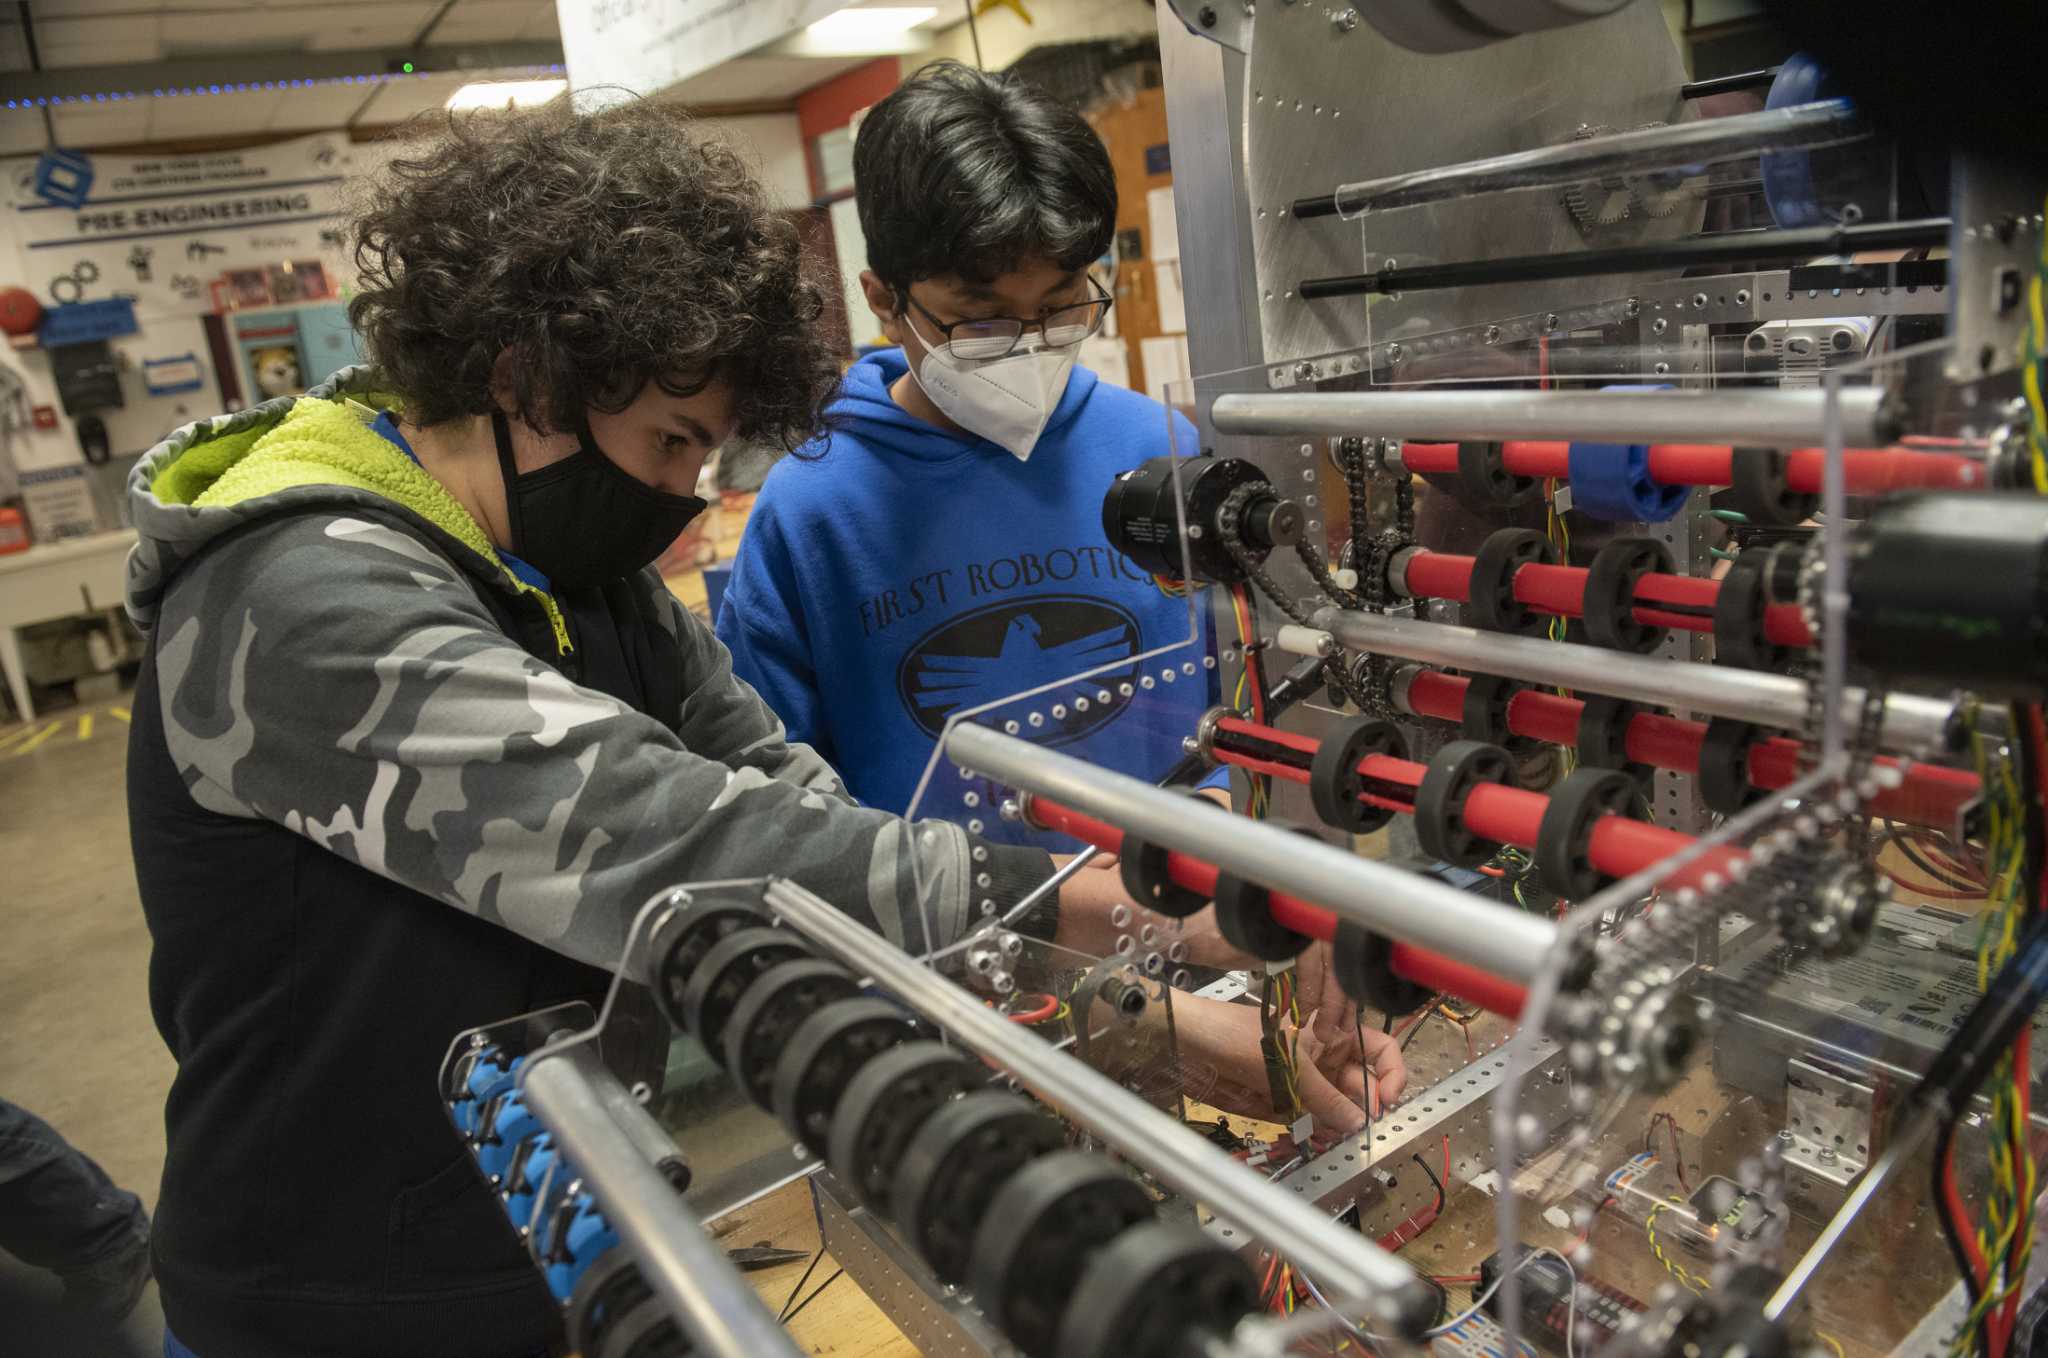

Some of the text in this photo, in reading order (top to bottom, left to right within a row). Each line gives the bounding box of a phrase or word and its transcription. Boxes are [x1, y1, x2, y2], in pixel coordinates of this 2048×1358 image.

[77, 194, 310, 231] PRE-ENGINEERING
[857, 547, 1155, 637] FIRST ROBOTIC
